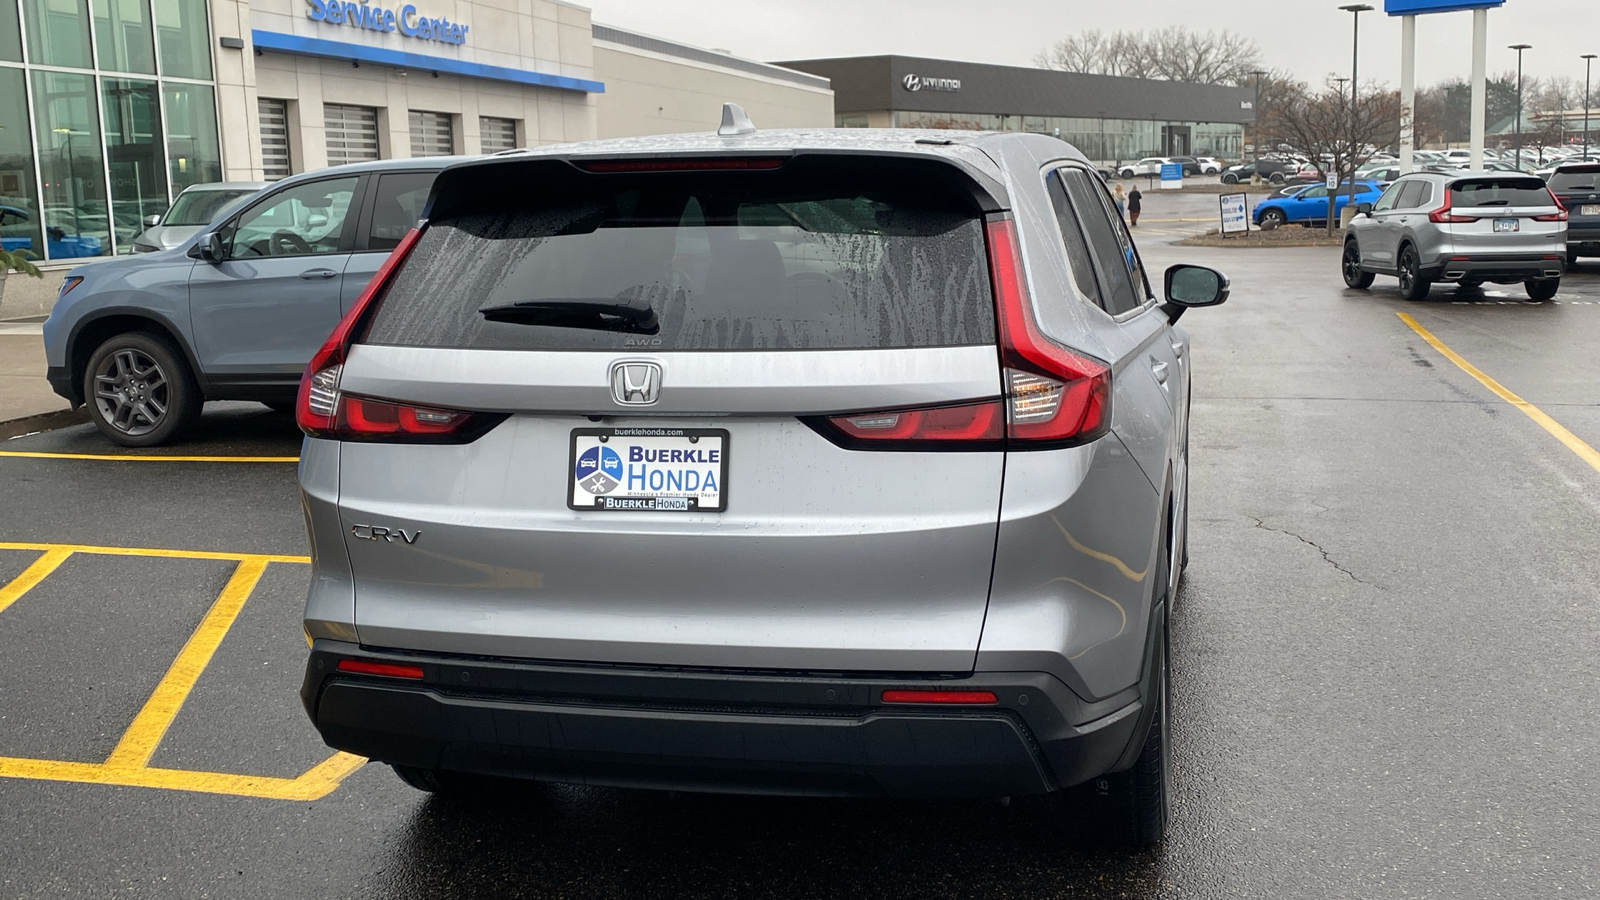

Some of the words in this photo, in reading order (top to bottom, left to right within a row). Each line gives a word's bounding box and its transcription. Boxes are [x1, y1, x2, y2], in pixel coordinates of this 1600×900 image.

[308, 0, 395, 33] Service
[398, 4, 469, 45] Center
[922, 77, 961, 89] HYUNDAI
[1328, 180, 1336, 188] 10
[624, 338, 662, 347] AWD
[614, 428, 684, 437] buerklehonda.com
[628, 445, 720, 463] BUERKLE
[627, 463, 718, 492] HONDA
[351, 523, 422, 544] CR-V
